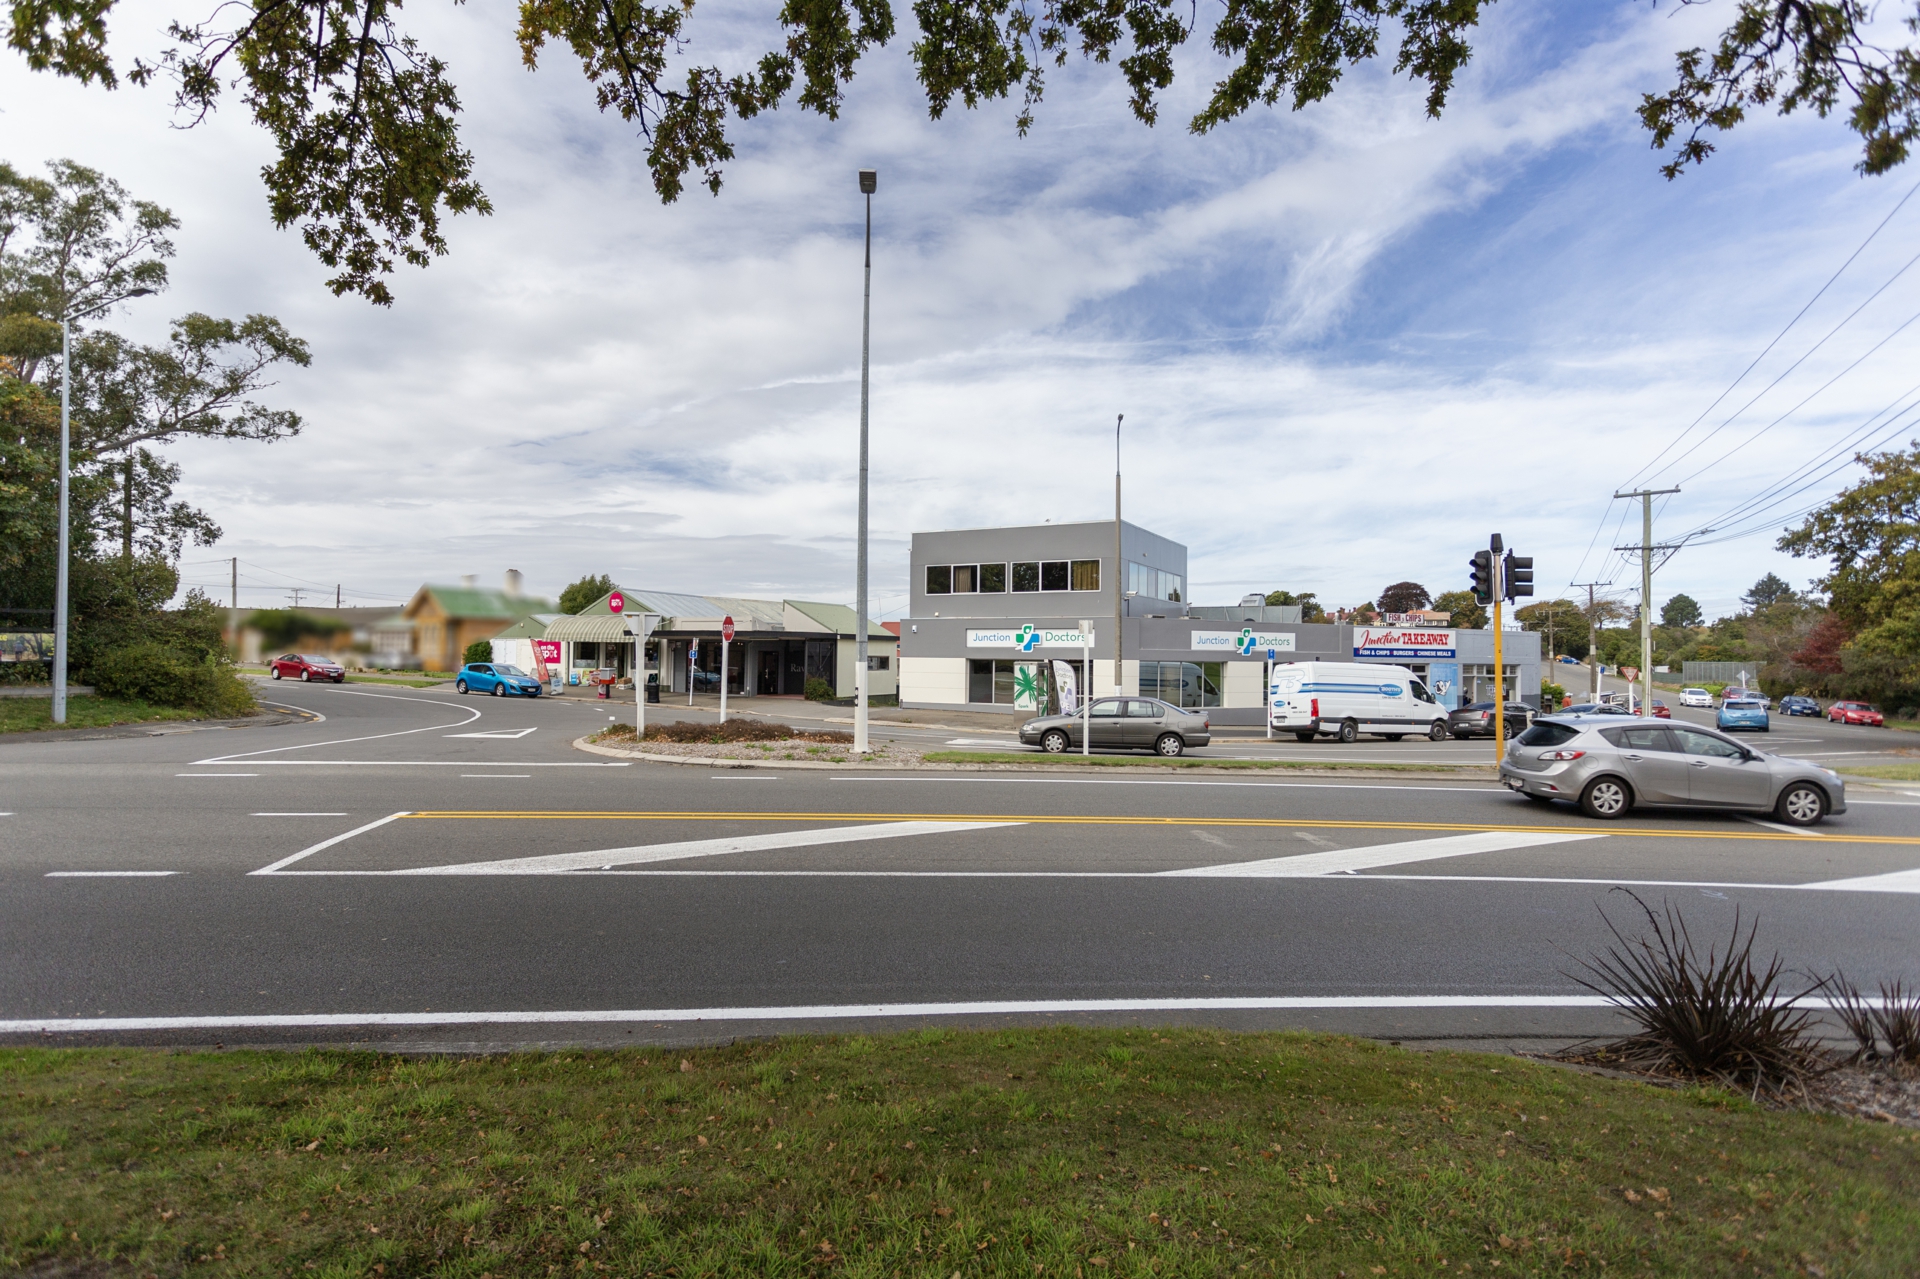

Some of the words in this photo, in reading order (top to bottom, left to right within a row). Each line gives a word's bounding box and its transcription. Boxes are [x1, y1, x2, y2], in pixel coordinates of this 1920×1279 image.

[1405, 614, 1421, 622] CHIPS
[723, 624, 734, 633] STOP
[973, 633, 1010, 642] Junction
[1045, 632, 1084, 642] Doctors
[1197, 636, 1229, 645] Junction
[1259, 636, 1290, 646] Doctors
[1358, 630, 1400, 650] Junction
[1401, 633, 1449, 645] TAKEAWAY
[1056, 671, 1073, 680] Doctors
